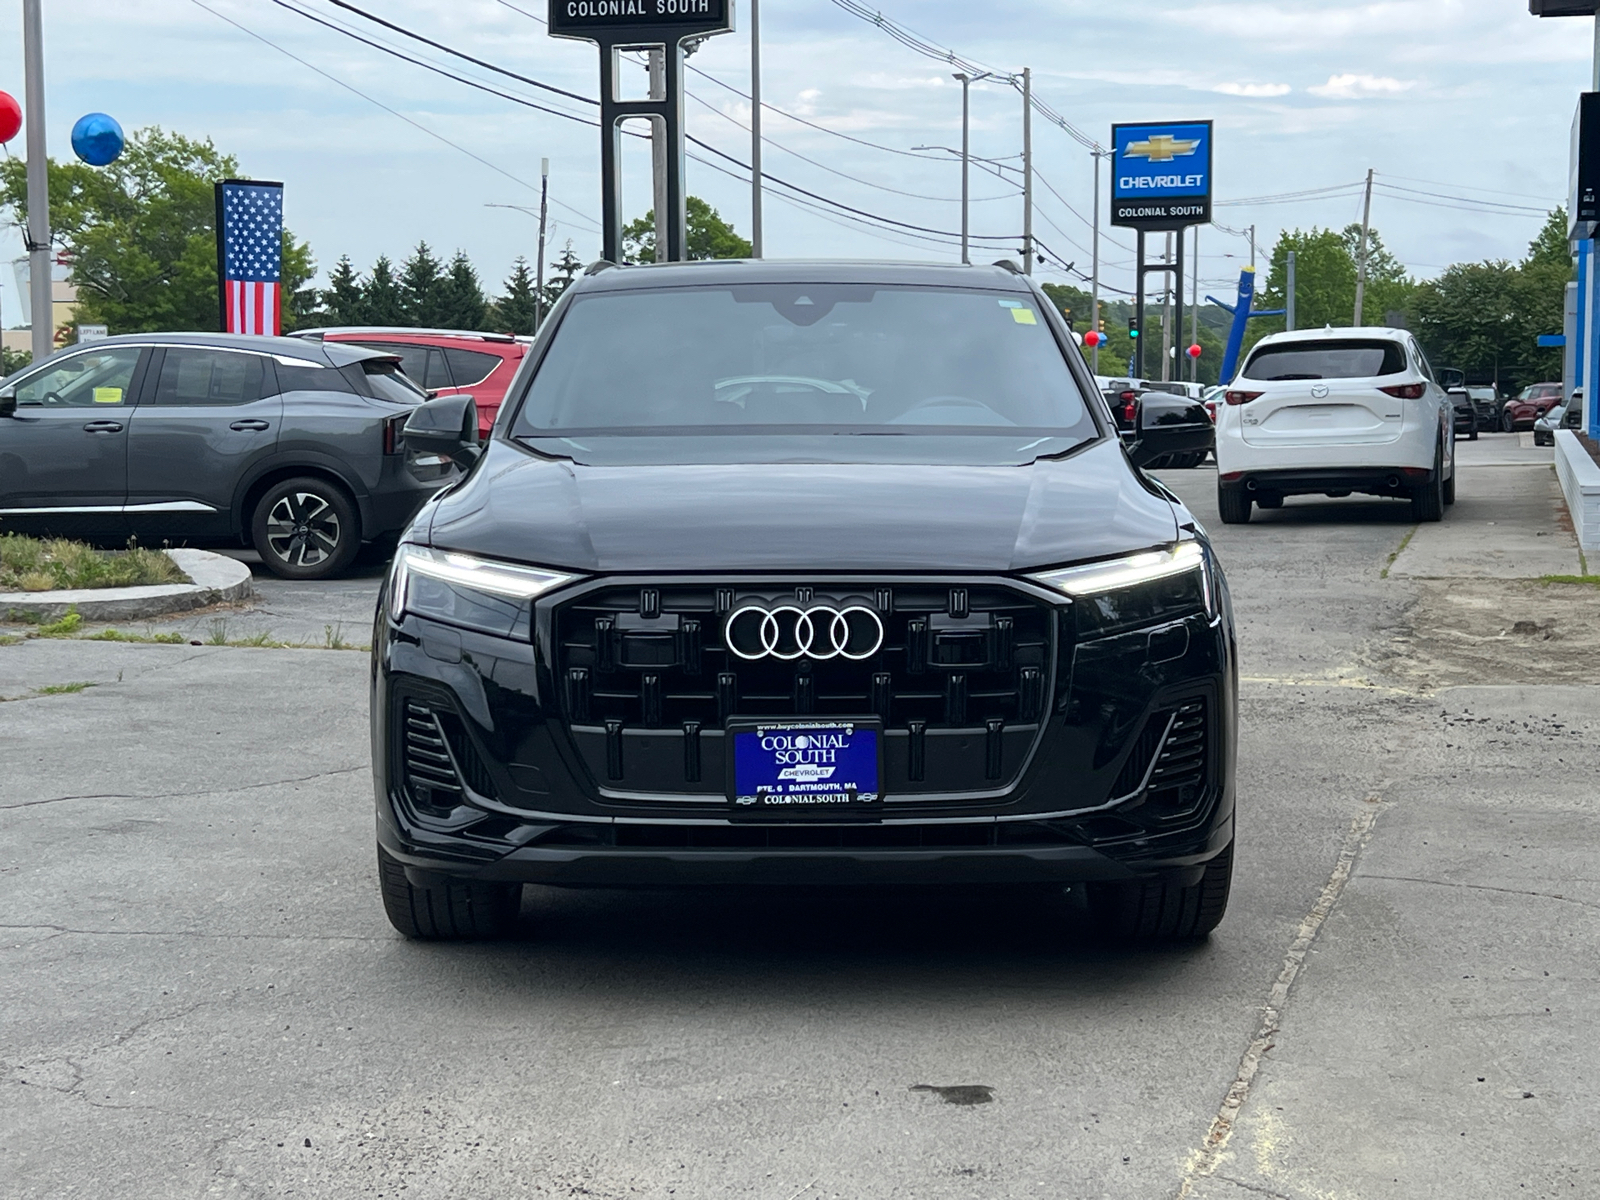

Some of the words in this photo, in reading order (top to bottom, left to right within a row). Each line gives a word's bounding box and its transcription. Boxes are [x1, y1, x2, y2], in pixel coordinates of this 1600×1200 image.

[567, 0, 646, 17] COLONIAL
[657, 0, 709, 14] SOUTH
[1119, 174, 1204, 189] CHEVROLET
[1118, 207, 1167, 218] COLONIAL
[1170, 206, 1204, 216] SOUTH
[761, 734, 849, 750] COLONIAL
[775, 749, 836, 764] SOUTH
[784, 769, 830, 777] CHEVROLET
[789, 783, 842, 792] DARTMOUTH,
[764, 794, 816, 804] COLONIAL
[817, 793, 849, 803] SOUTH
